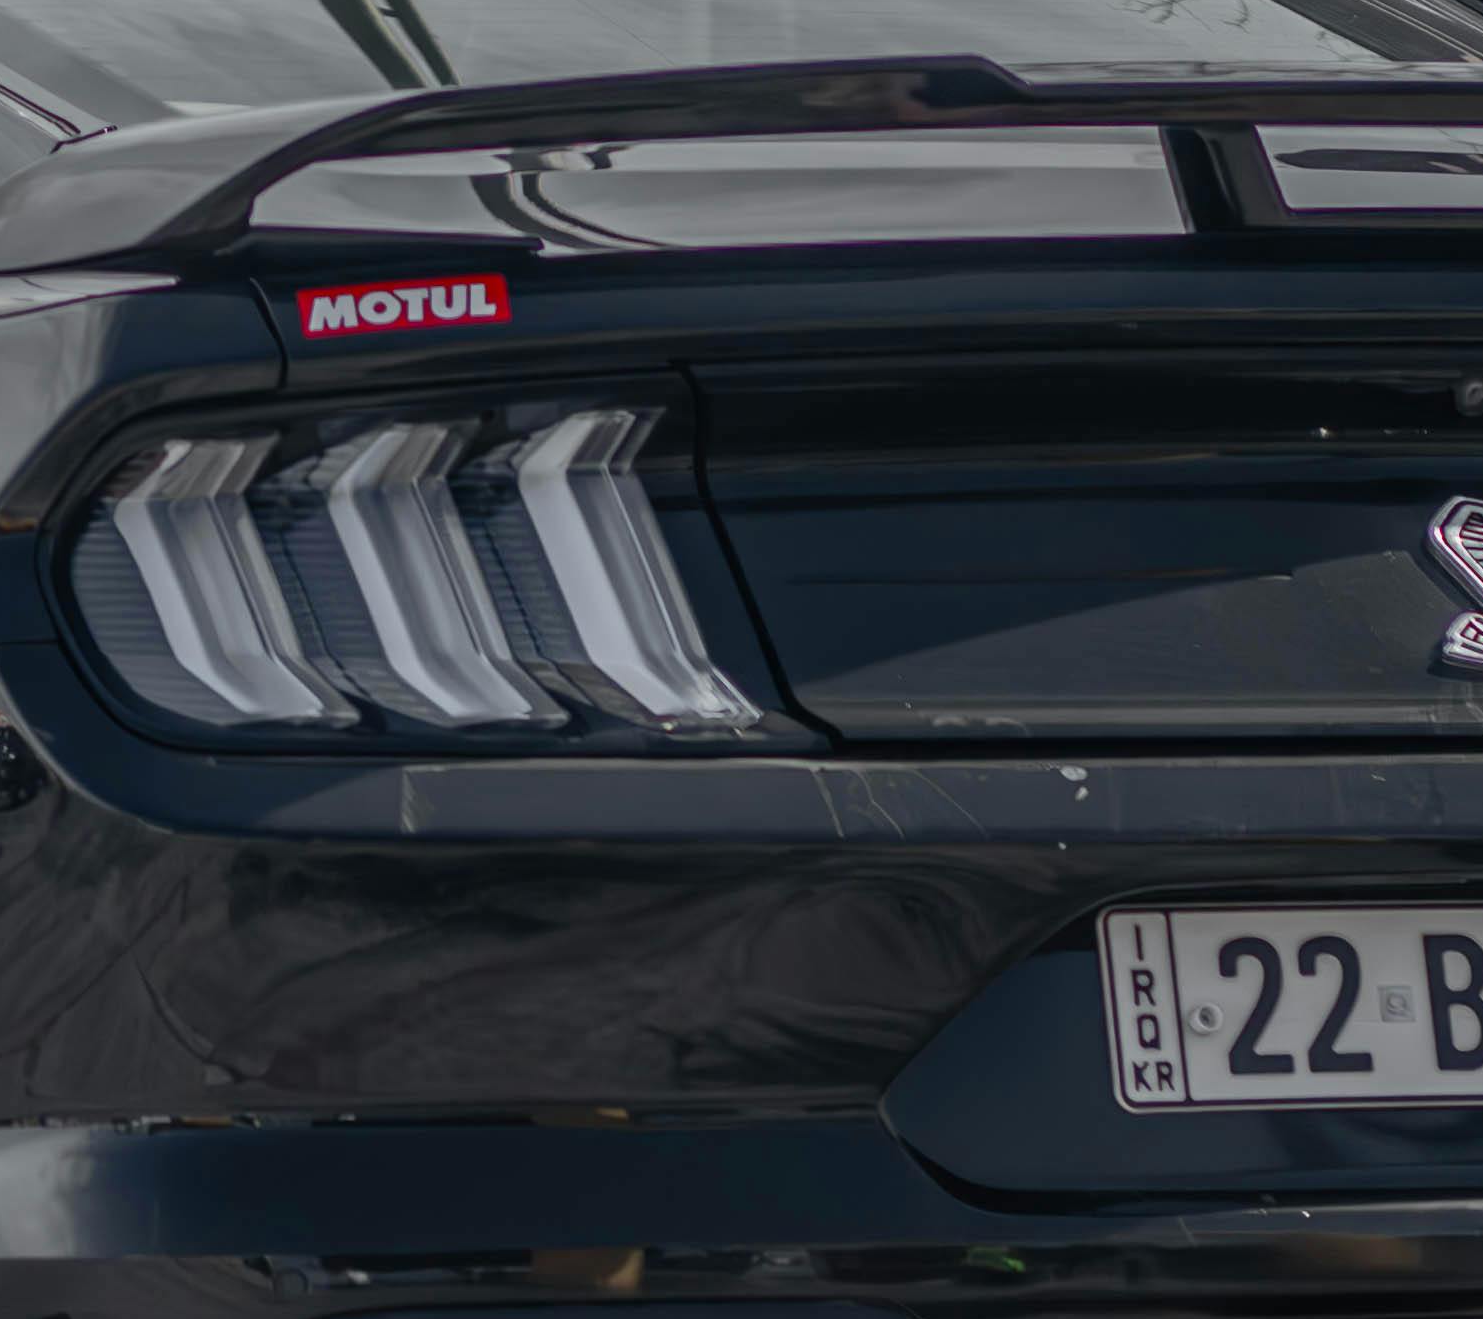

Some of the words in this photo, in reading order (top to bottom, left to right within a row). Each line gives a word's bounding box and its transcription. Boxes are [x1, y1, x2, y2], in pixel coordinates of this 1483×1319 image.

[308, 283, 497, 332] MOTUL
[1131, 923, 1161, 1050] IRQ
[1218, 935, 1375, 1075] 22
[1132, 1061, 1176, 1093] KR
